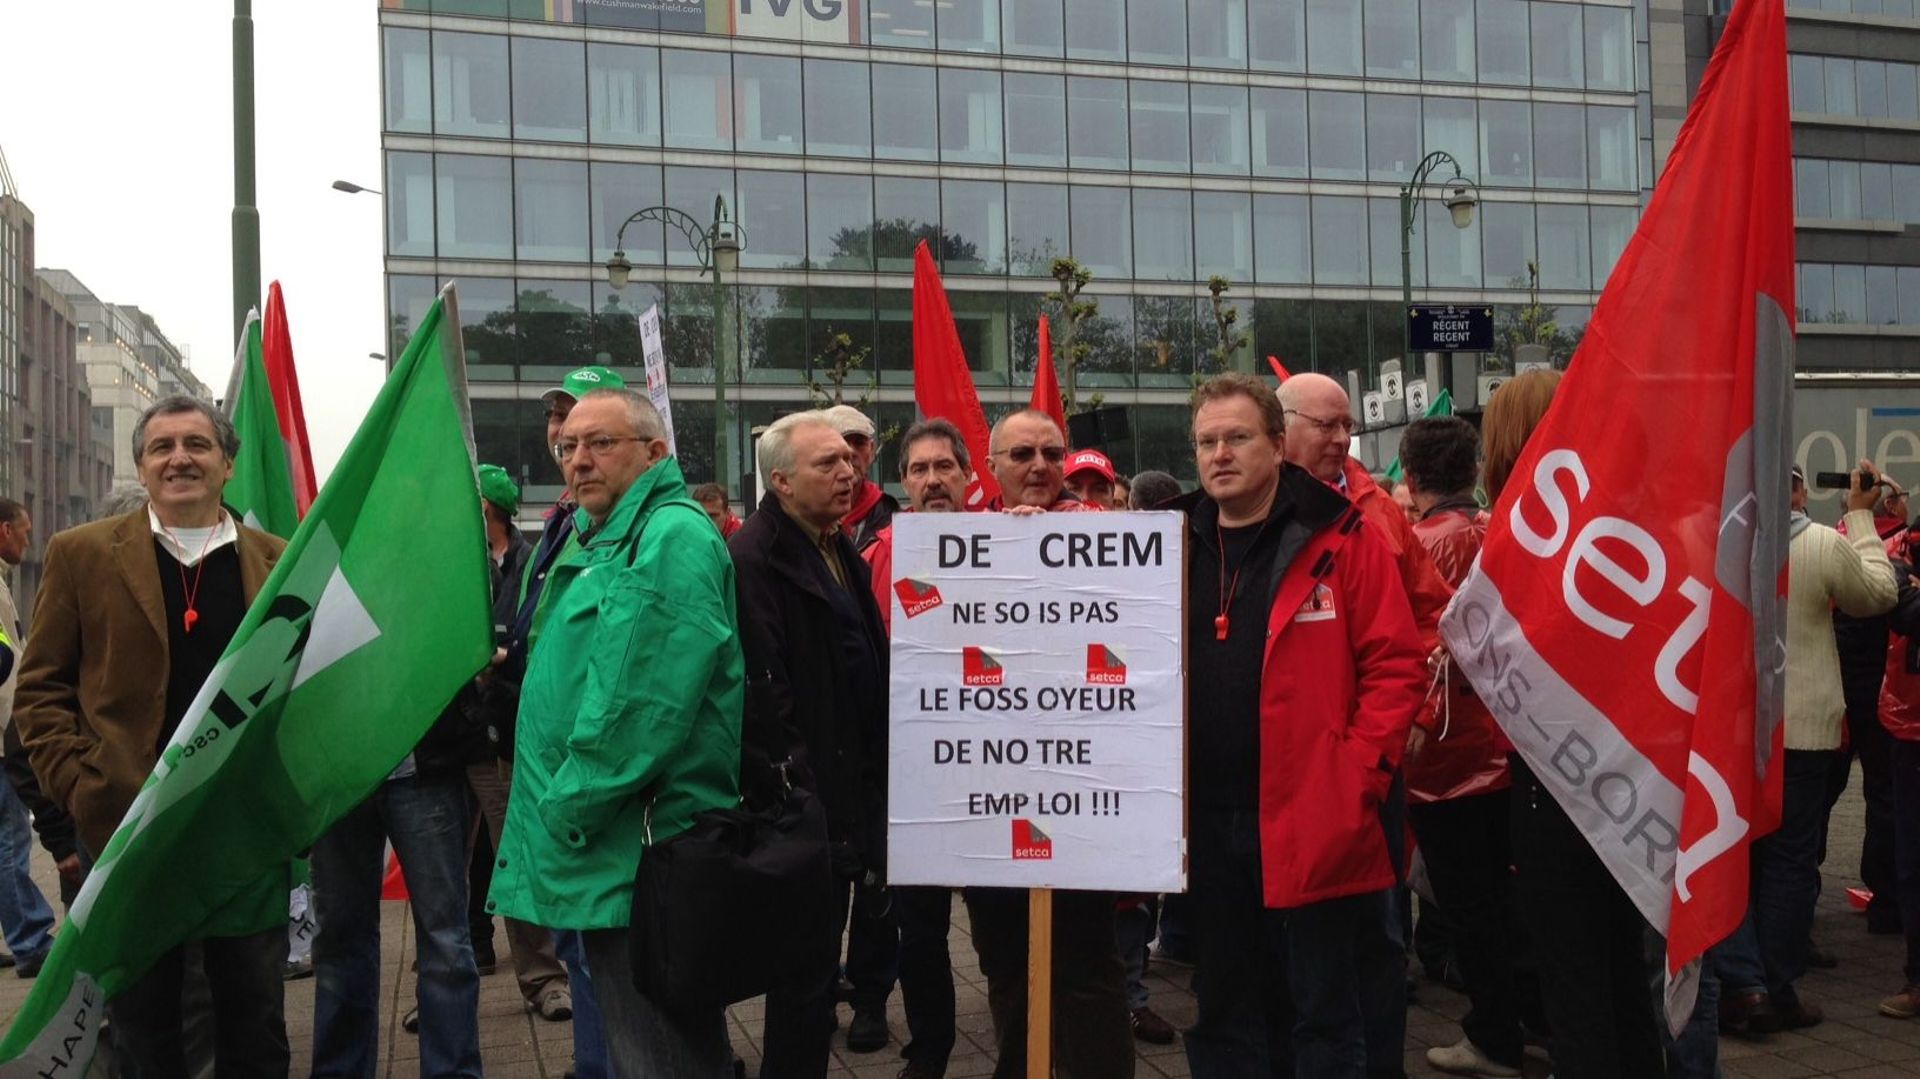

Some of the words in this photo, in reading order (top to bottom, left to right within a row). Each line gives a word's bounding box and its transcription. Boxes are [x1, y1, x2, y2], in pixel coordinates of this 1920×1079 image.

[939, 534, 991, 568] DE
[1039, 532, 1162, 568] CREM
[908, 595, 940, 616] setca
[953, 602, 986, 624] NE
[994, 602, 1029, 624] SO
[1040, 602, 1060, 624] IS
[1070, 602, 1119, 624] PAS
[966, 674, 1001, 684] setca
[1090, 672, 1124, 683] setca
[920, 687, 948, 711] LE
[959, 687, 1028, 711] FOSS
[1037, 687, 1136, 711] OYEUR
[934, 739, 972, 765] DE
[983, 739, 1029, 765] NO
[1036, 739, 1092, 765] TRE
[968, 793, 1028, 816] EMP
[1038, 793, 1080, 816] LOI
[1092, 792, 1120, 816] !!!
[1015, 848, 1049, 858] setca
